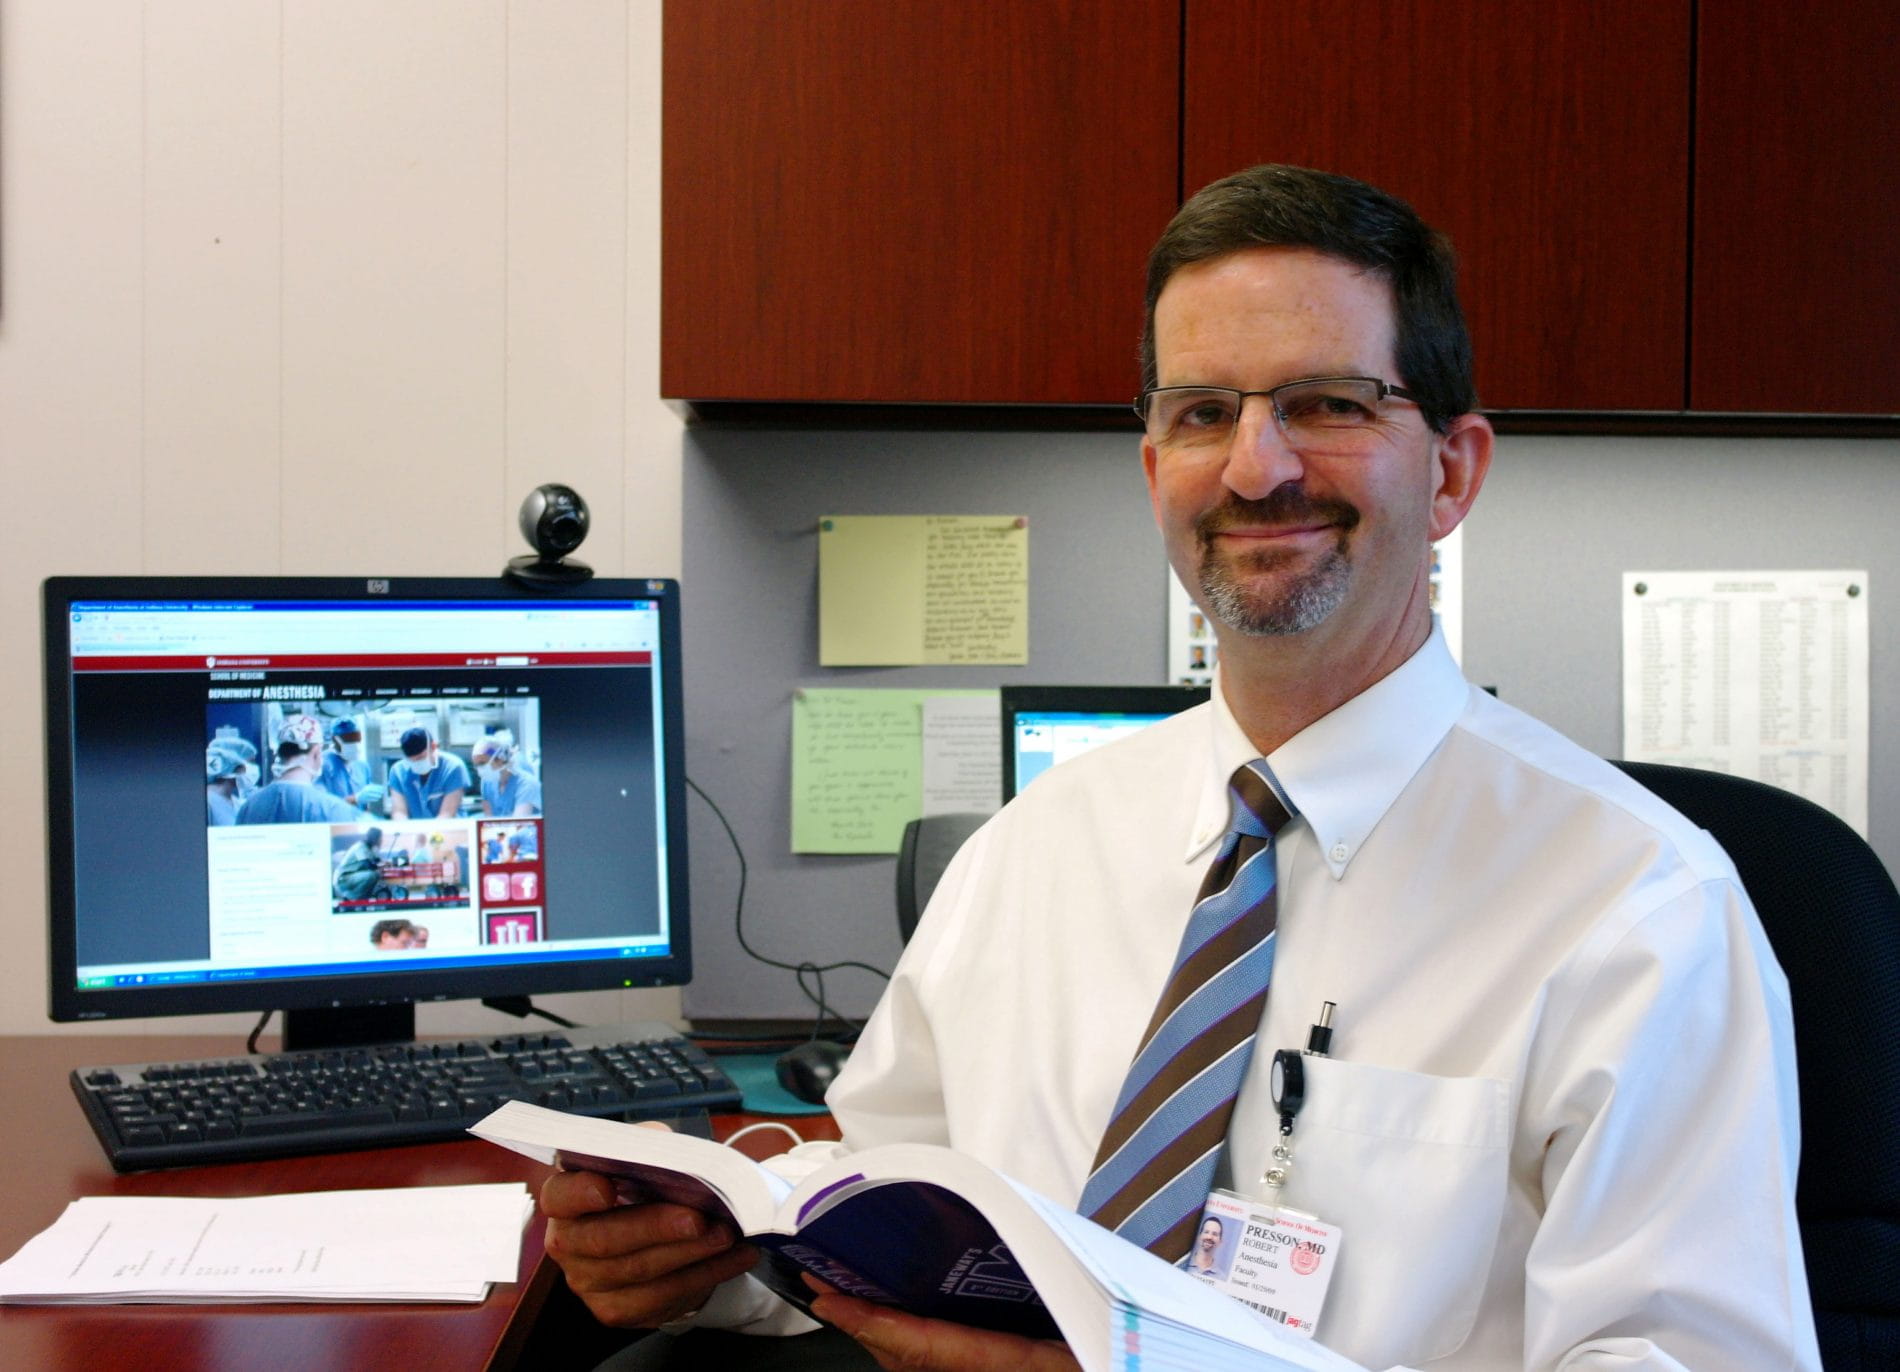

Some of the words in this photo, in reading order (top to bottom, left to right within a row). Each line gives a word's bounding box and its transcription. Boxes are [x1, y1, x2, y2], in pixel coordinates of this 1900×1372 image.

[208, 688, 251, 699] DEPARTMENT
[251, 687, 262, 698] OF
[262, 685, 326, 699] ANESTHESIA
[1242, 1237, 1280, 1254] ROBERT
[1304, 1241, 1326, 1255] MD
[1238, 1252, 1278, 1270] Anesthesia
[938, 1247, 983, 1295] JANEWAY'S
[1234, 1264, 1258, 1278] Faculty
